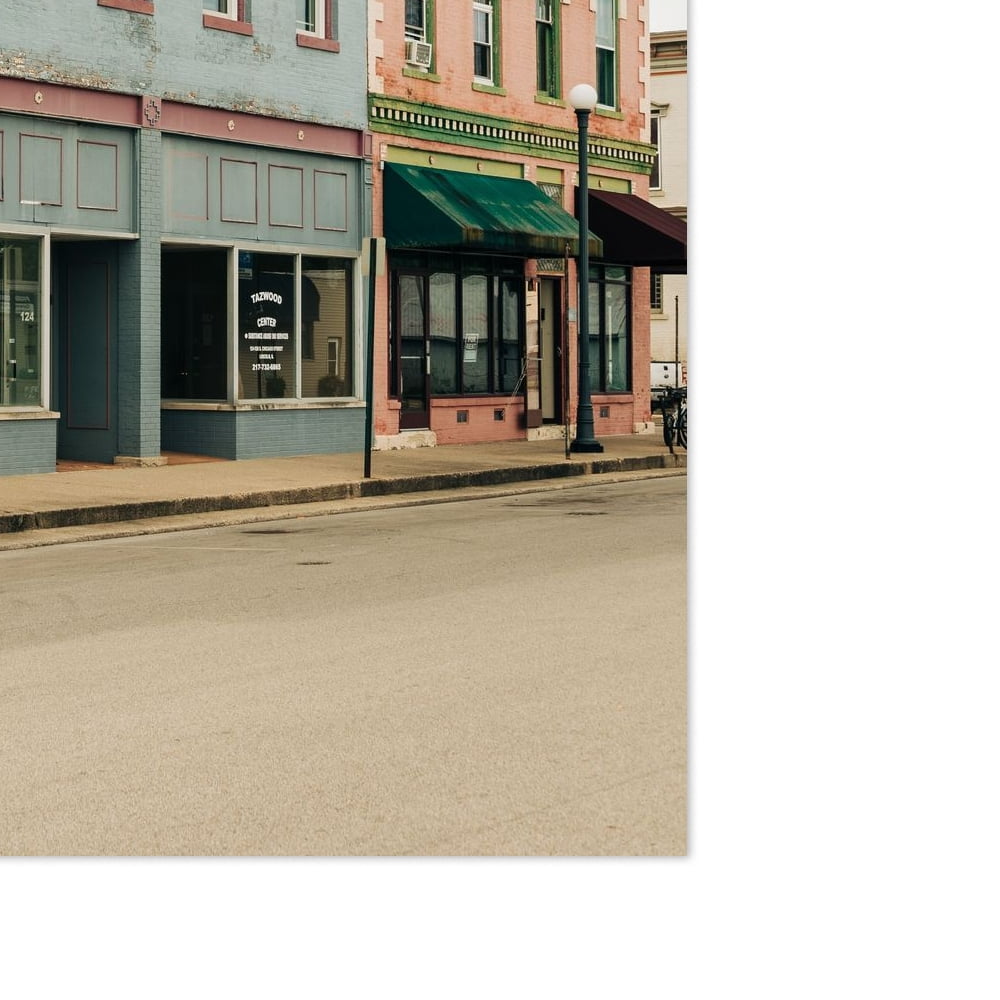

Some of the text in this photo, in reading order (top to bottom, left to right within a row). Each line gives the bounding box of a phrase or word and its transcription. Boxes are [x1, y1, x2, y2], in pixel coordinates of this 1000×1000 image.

[250, 291, 283, 305] TAZWOOD
[20, 311, 35, 322] 124
[256, 316, 277, 328] CENTER
